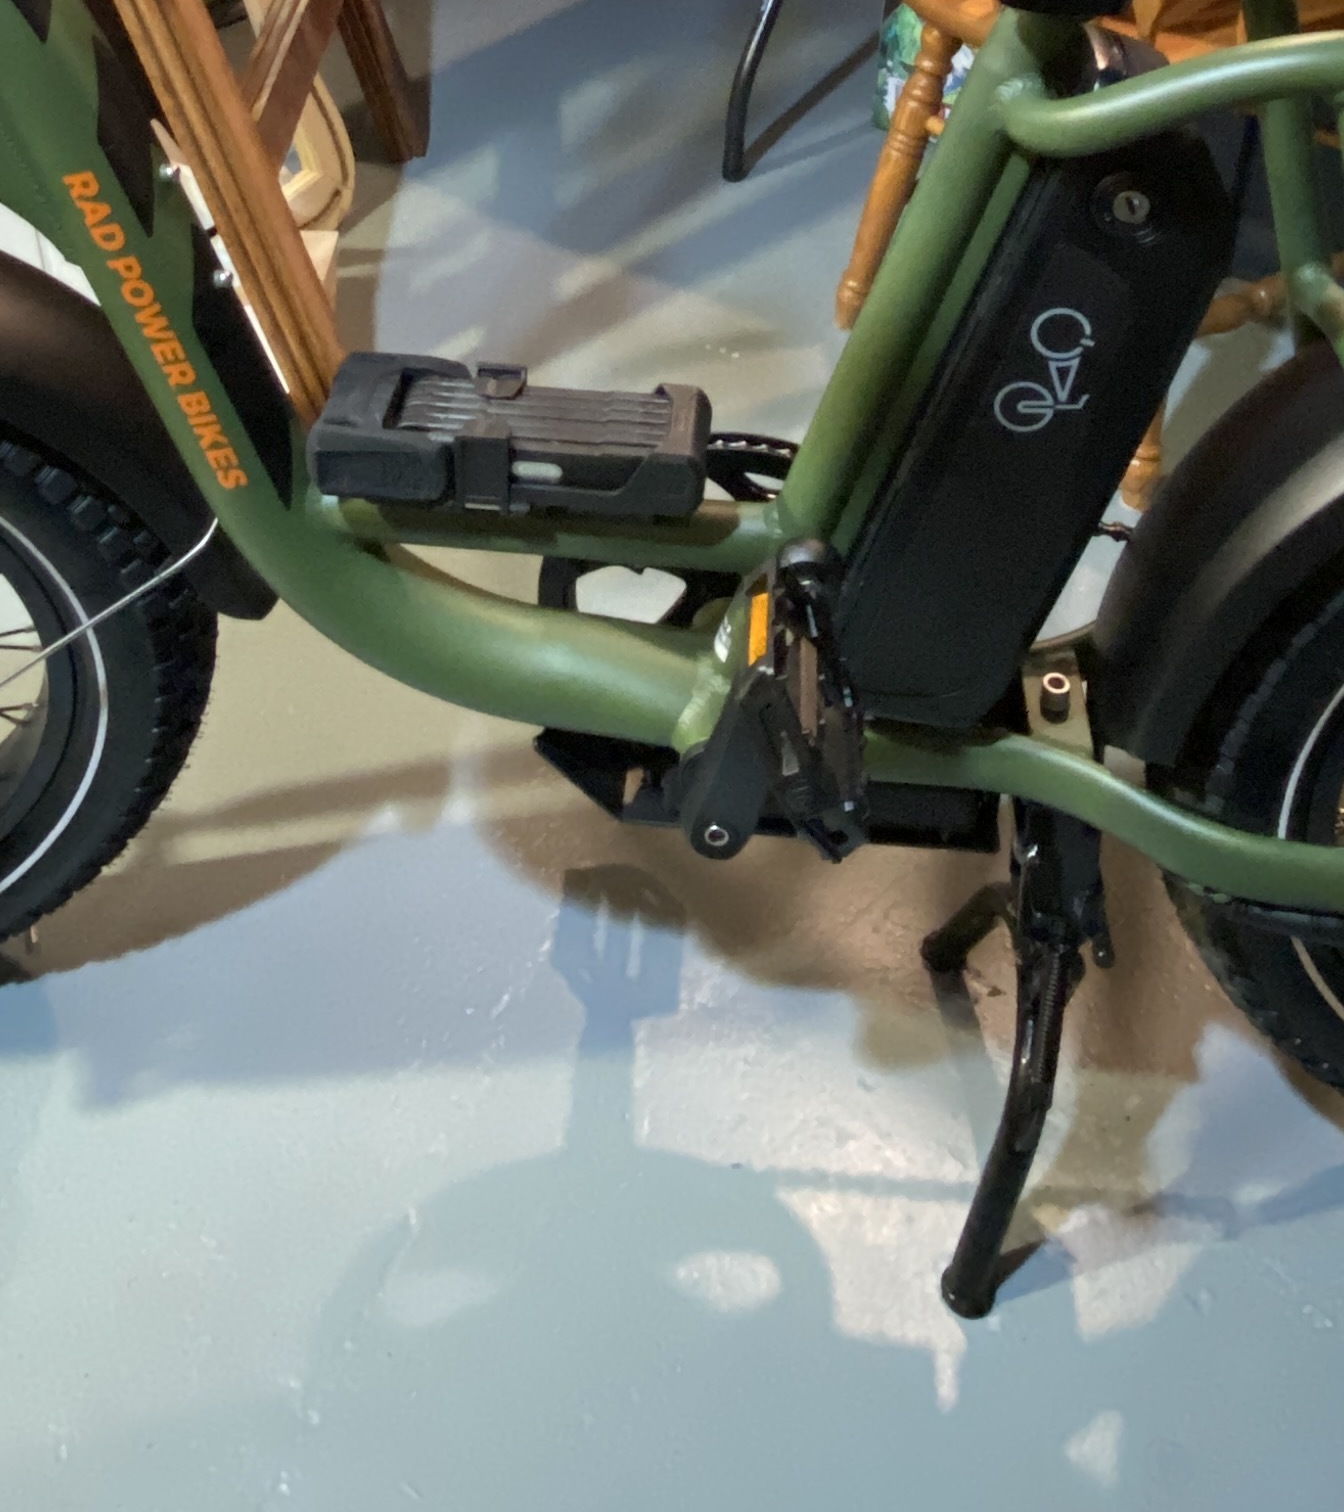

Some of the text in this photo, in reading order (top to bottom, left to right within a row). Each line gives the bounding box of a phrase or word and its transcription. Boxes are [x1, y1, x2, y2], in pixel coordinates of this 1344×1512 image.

[62, 170, 249, 492] RAD POWER BIKES
